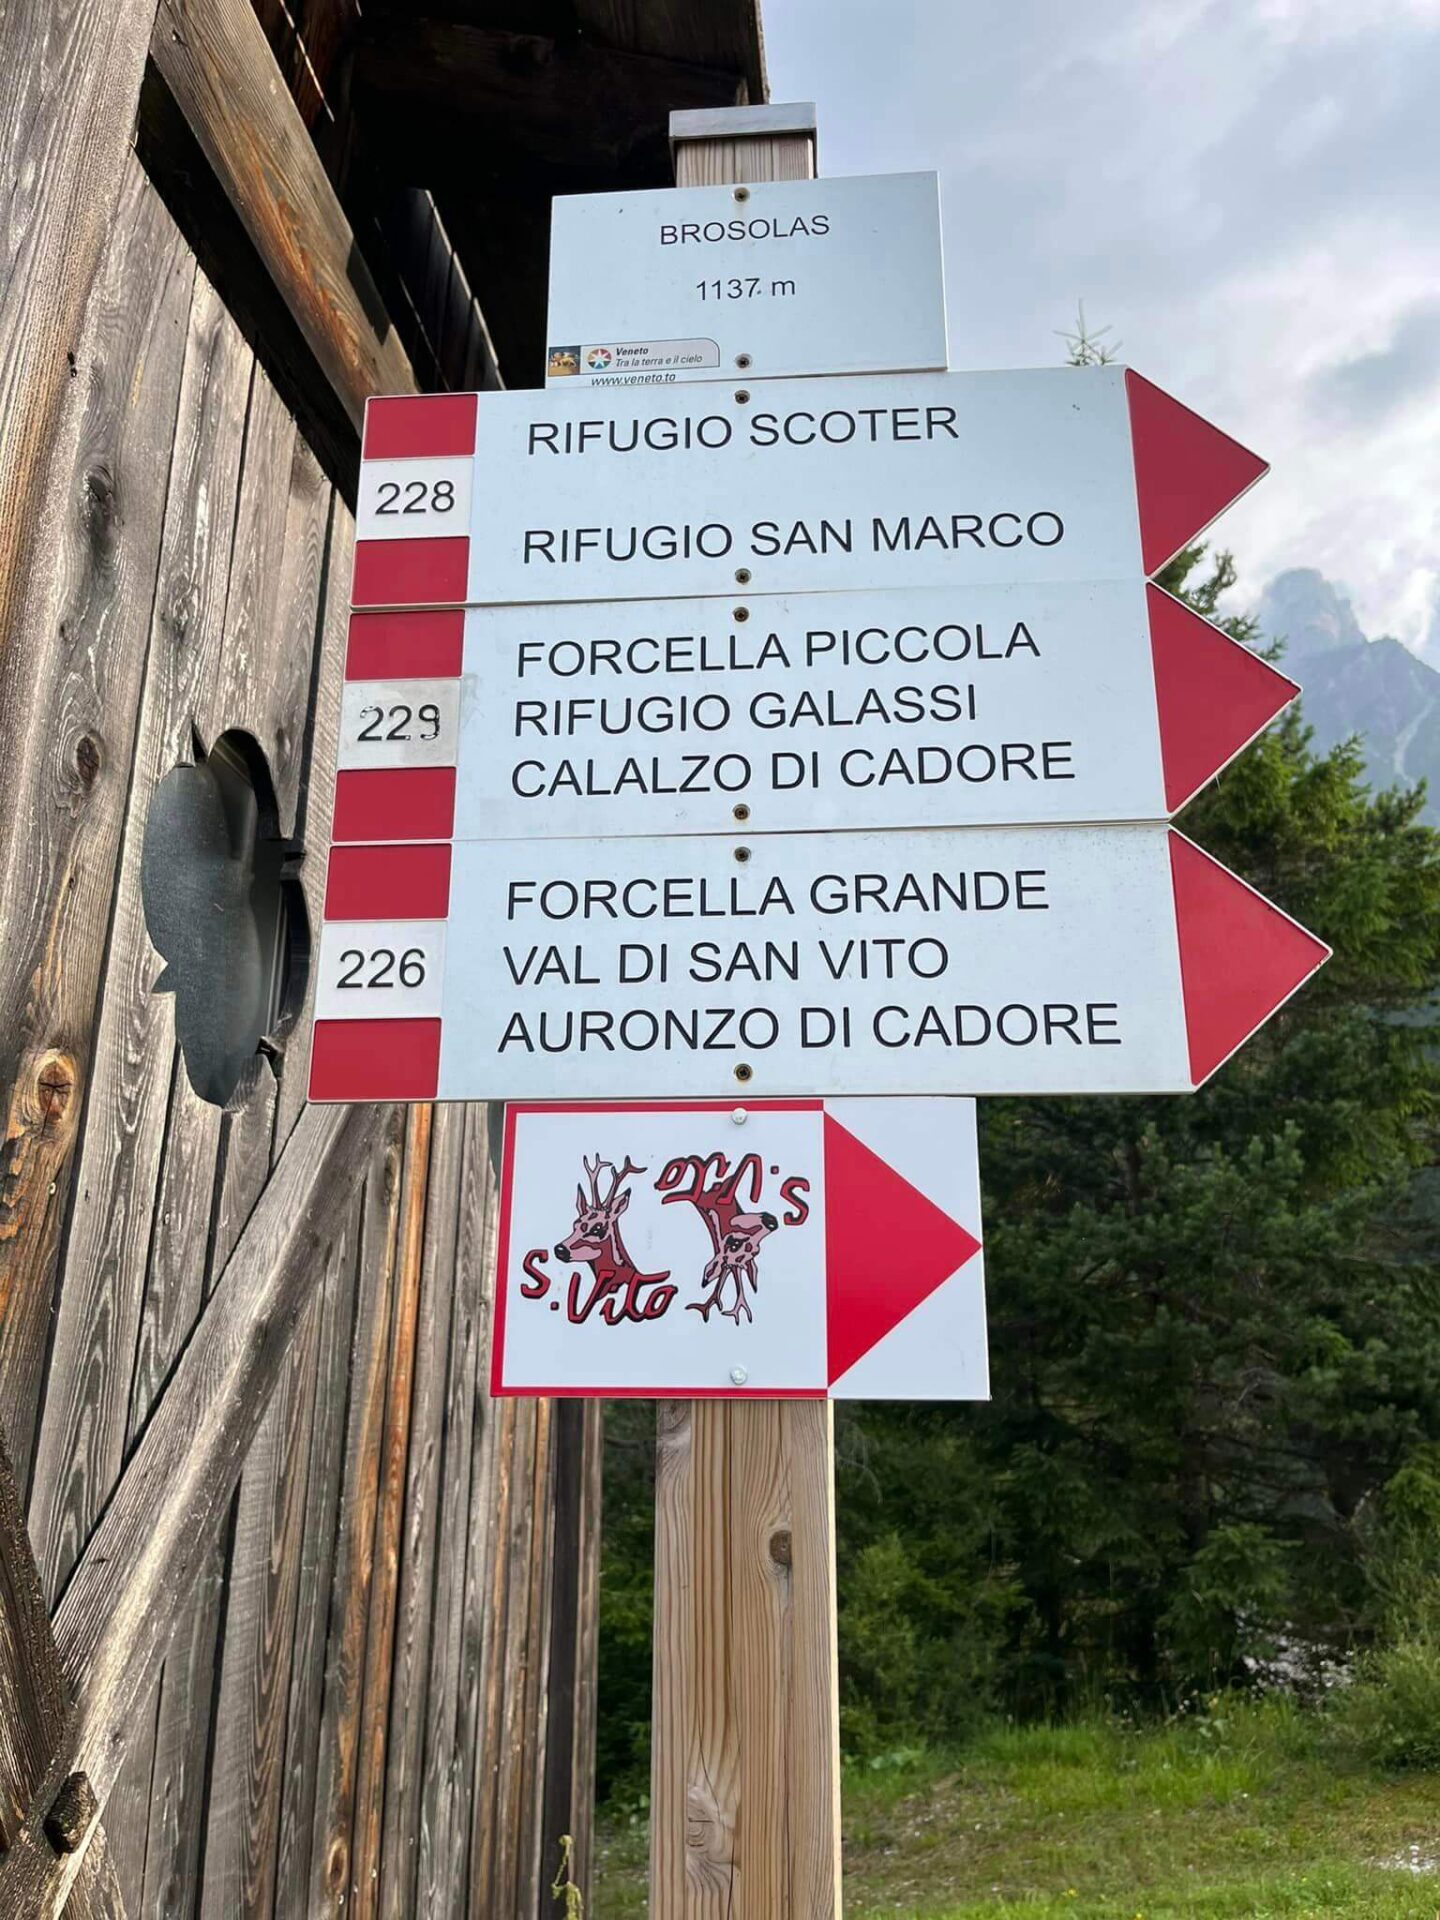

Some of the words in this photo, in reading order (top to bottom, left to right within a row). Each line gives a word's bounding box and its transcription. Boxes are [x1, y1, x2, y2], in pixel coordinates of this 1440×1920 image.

[660, 215, 830, 245] BROSOLAS
[696, 277, 760, 301] 1137
[771, 280, 795, 296] m
[616, 347, 649, 356] Veneto
[616, 359, 630, 368] Tra
[631, 358, 640, 367] la
[641, 356, 664, 366] terra
[681, 355, 703, 363] cielo
[591, 373, 676, 386] www.veneto.to
[528, 415, 732, 455] RIFUGIO
[749, 406, 959, 446] SCOTER
[375, 480, 455, 515] 228
[524, 523, 733, 564] RIFUGIO
[750, 519, 852, 556] SAN
[872, 511, 1064, 552] MARCO
[518, 633, 791, 678] FORCELLA
[806, 622, 1041, 667] PICCOLA
[357, 704, 441, 742] 229
[515, 694, 731, 737] RIFUGIO
[749, 684, 976, 729] GALASSI
[511, 753, 752, 798] CALALZO
[772, 751, 819, 790] DI
[840, 741, 1076, 787] CADORE
[507, 876, 795, 920] FORCELLA
[810, 870, 1049, 915] GRANDE
[336, 948, 425, 989] 226
[503, 945, 601, 986] VAL
[619, 943, 667, 984] DI
[689, 941, 799, 983] SAN
[818, 937, 949, 980] VITO
[497, 1009, 779, 1053] AURONZO
[800, 1006, 851, 1049] DI
[873, 1003, 1122, 1048] CADORE
